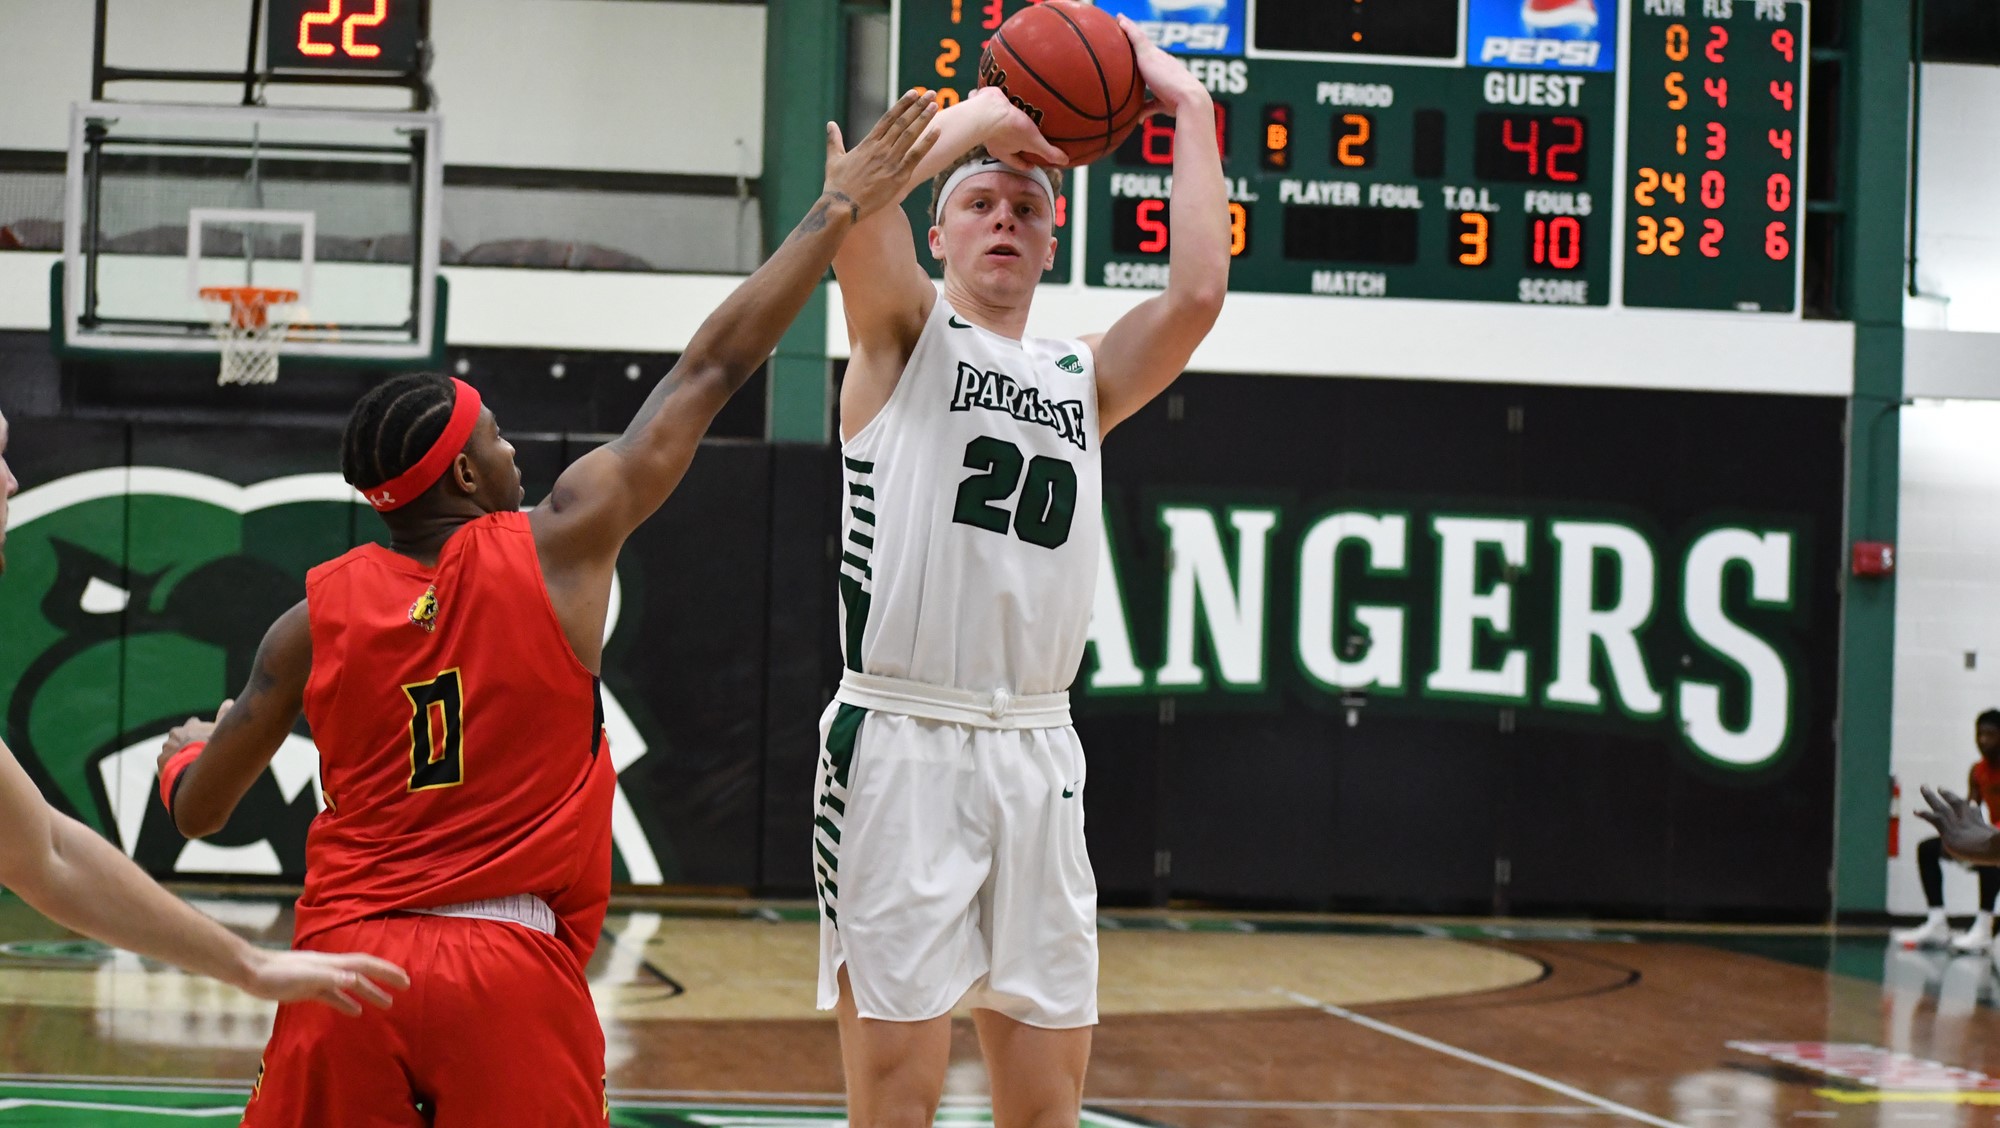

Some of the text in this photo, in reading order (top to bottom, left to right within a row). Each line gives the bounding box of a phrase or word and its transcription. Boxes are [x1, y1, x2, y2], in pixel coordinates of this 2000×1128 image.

[1702, 0, 1733, 19] FLS
[1754, 0, 1786, 22] PTS
[1137, 21, 1230, 51] EPSI
[1480, 36, 1601, 67] PEPSI
[1665, 23, 1794, 64] 0 2 9
[935, 38, 961, 78] 2
[1316, 81, 1394, 107] PERIOD
[1483, 71, 1585, 107] GUEST
[1664, 71, 1793, 112] 5 4 4
[1337, 113, 1371, 167] 2
[1502, 117, 1585, 181] 42
[1676, 121, 1792, 160] 1 3 4
[1279, 179, 1423, 209] PLAYER FOUL
[1524, 190, 1592, 216] FOULS
[1634, 167, 1791, 212] 24 0 0
[1136, 199, 1167, 253] 5
[1459, 212, 1489, 266] 3
[1533, 216, 1581, 270] 10
[1636, 215, 1789, 261] 32 2 6
[1311, 270, 1387, 296] MATCH
[1518, 277, 1588, 304] SCORE
[952, 435, 1078, 550] 20
